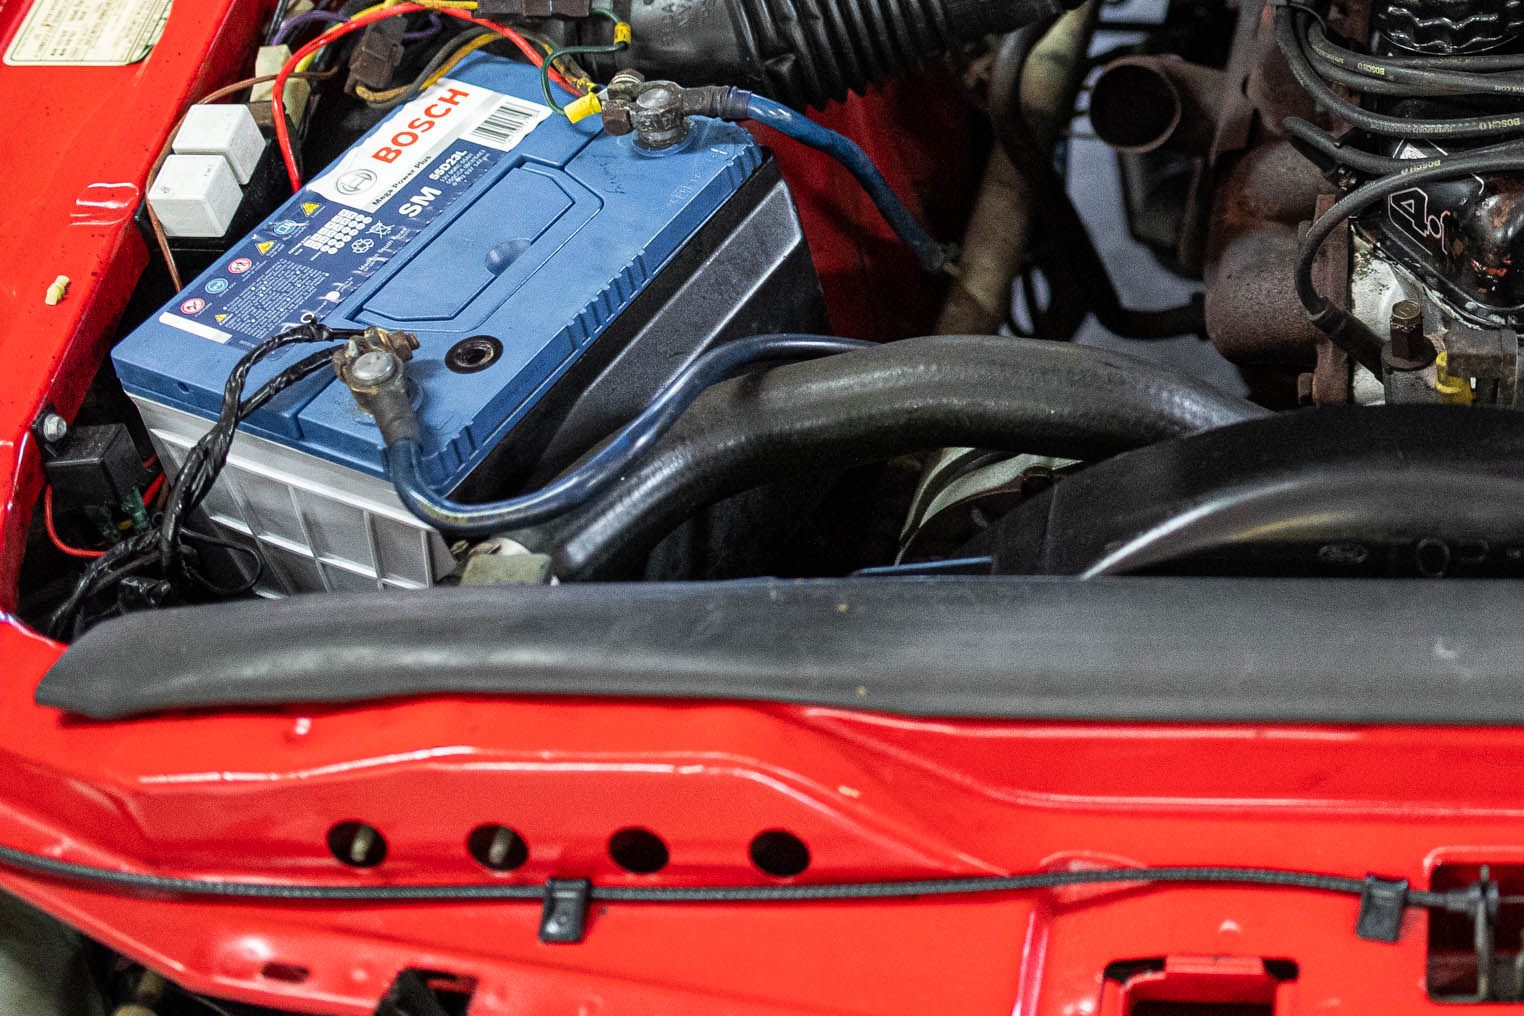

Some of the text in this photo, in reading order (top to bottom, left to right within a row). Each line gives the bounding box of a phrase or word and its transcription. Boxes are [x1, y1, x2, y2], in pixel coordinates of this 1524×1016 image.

[1362, 64, 1385, 76] BOSCH
[1494, 84, 1511, 92] CORE
[371, 88, 470, 164] BOSCH
[1488, 117, 1521, 130] BOSCH
[1410, 159, 1441, 174] BOSCH
[372, 189, 393, 205] Mega
[414, 156, 431, 168] Plus
[398, 186, 442, 217] SM
